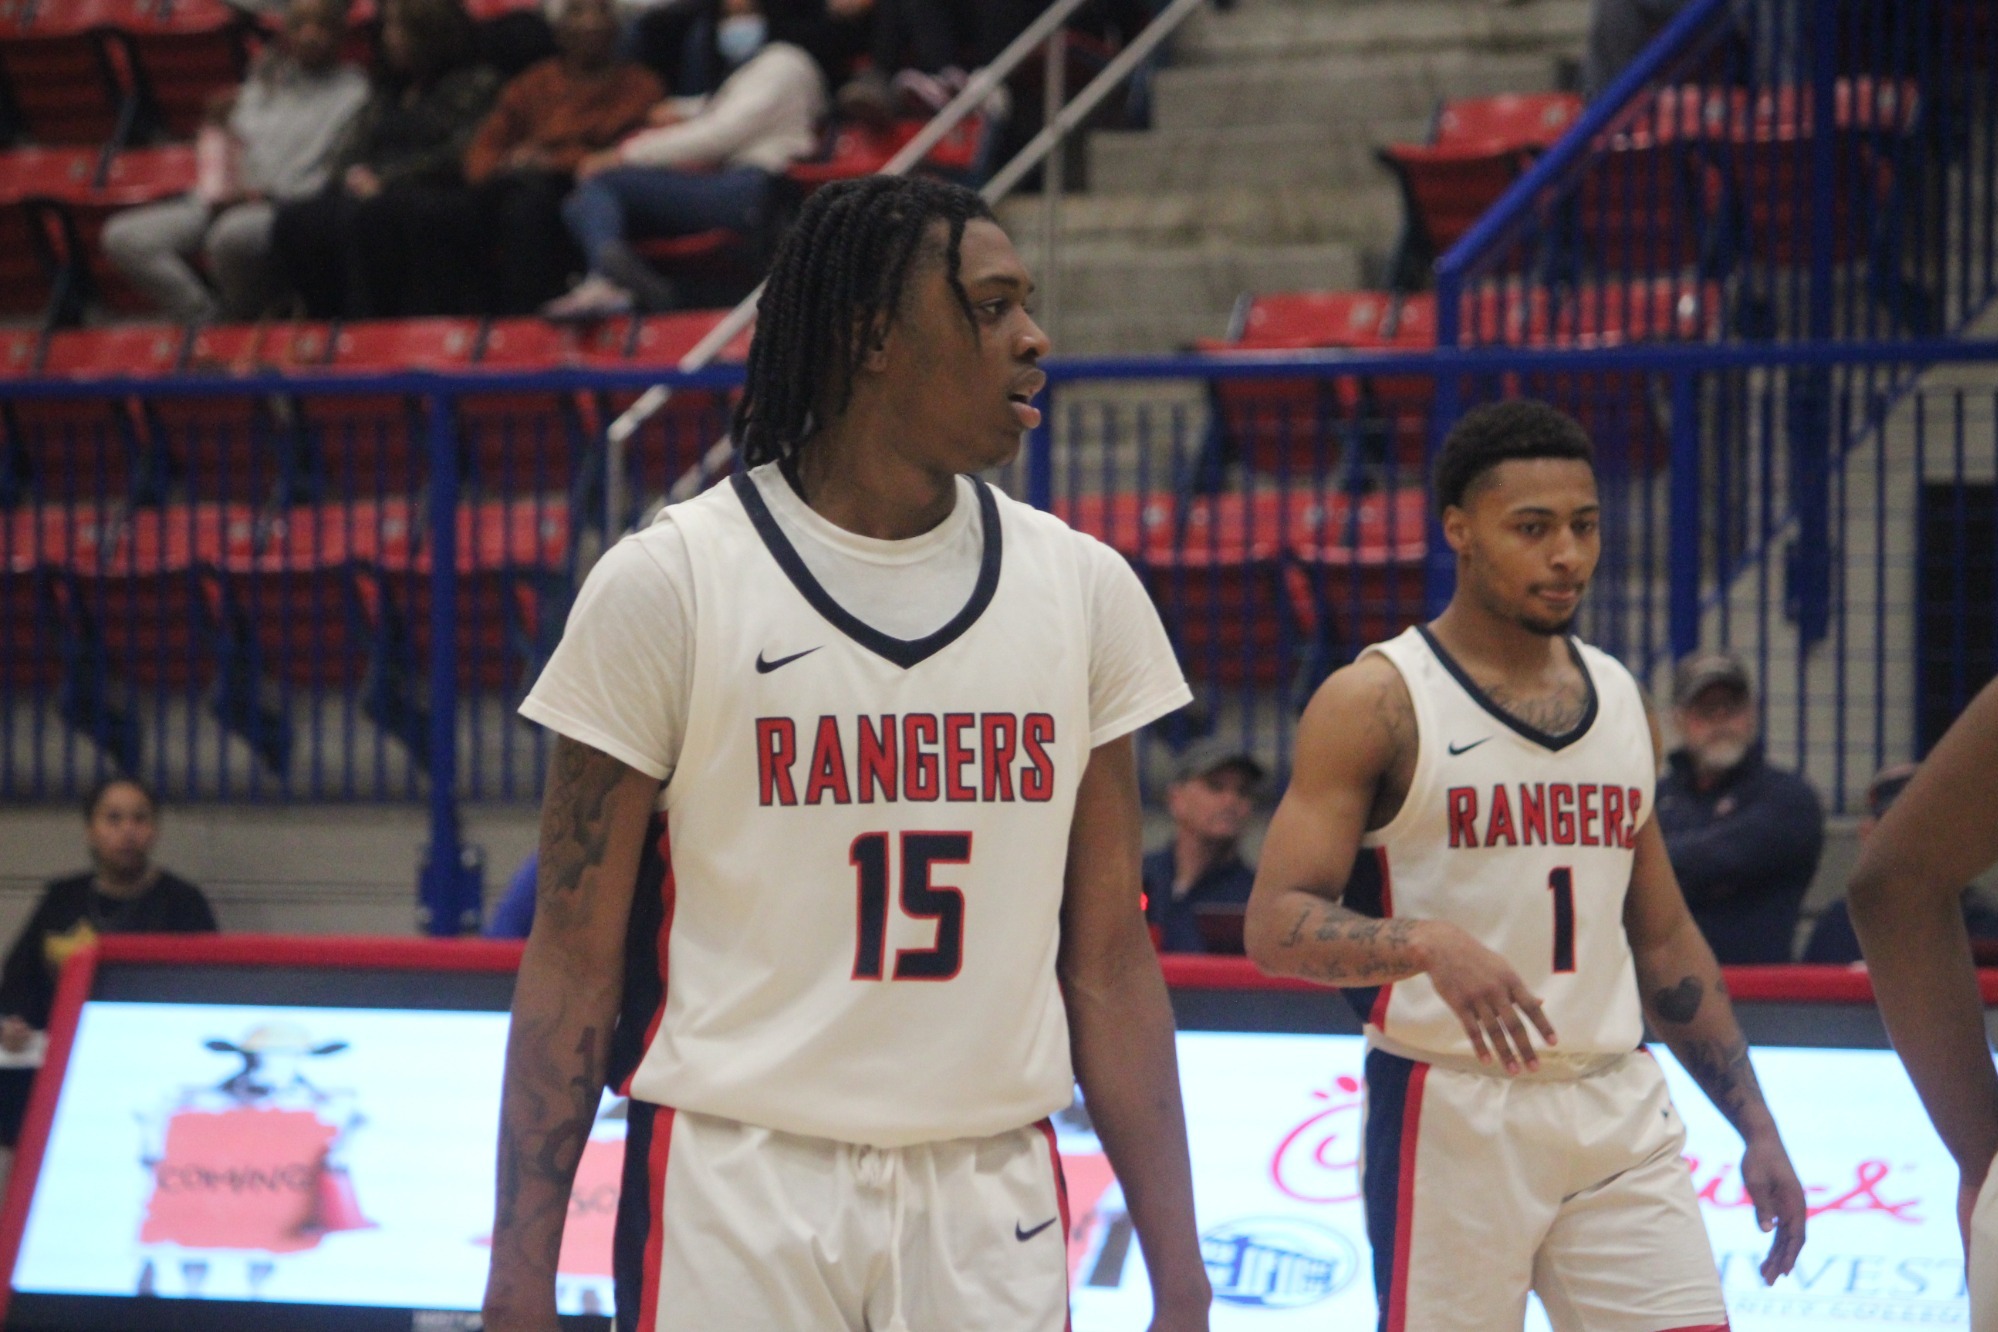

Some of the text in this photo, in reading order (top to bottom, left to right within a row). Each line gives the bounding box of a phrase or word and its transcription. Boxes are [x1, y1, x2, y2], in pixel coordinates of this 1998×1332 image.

[755, 712, 1055, 807] RANGERS
[1447, 782, 1642, 849] RANGERS
[848, 830, 973, 982] 15
[1547, 865, 1577, 974] 1
[157, 1162, 317, 1196] COMING
